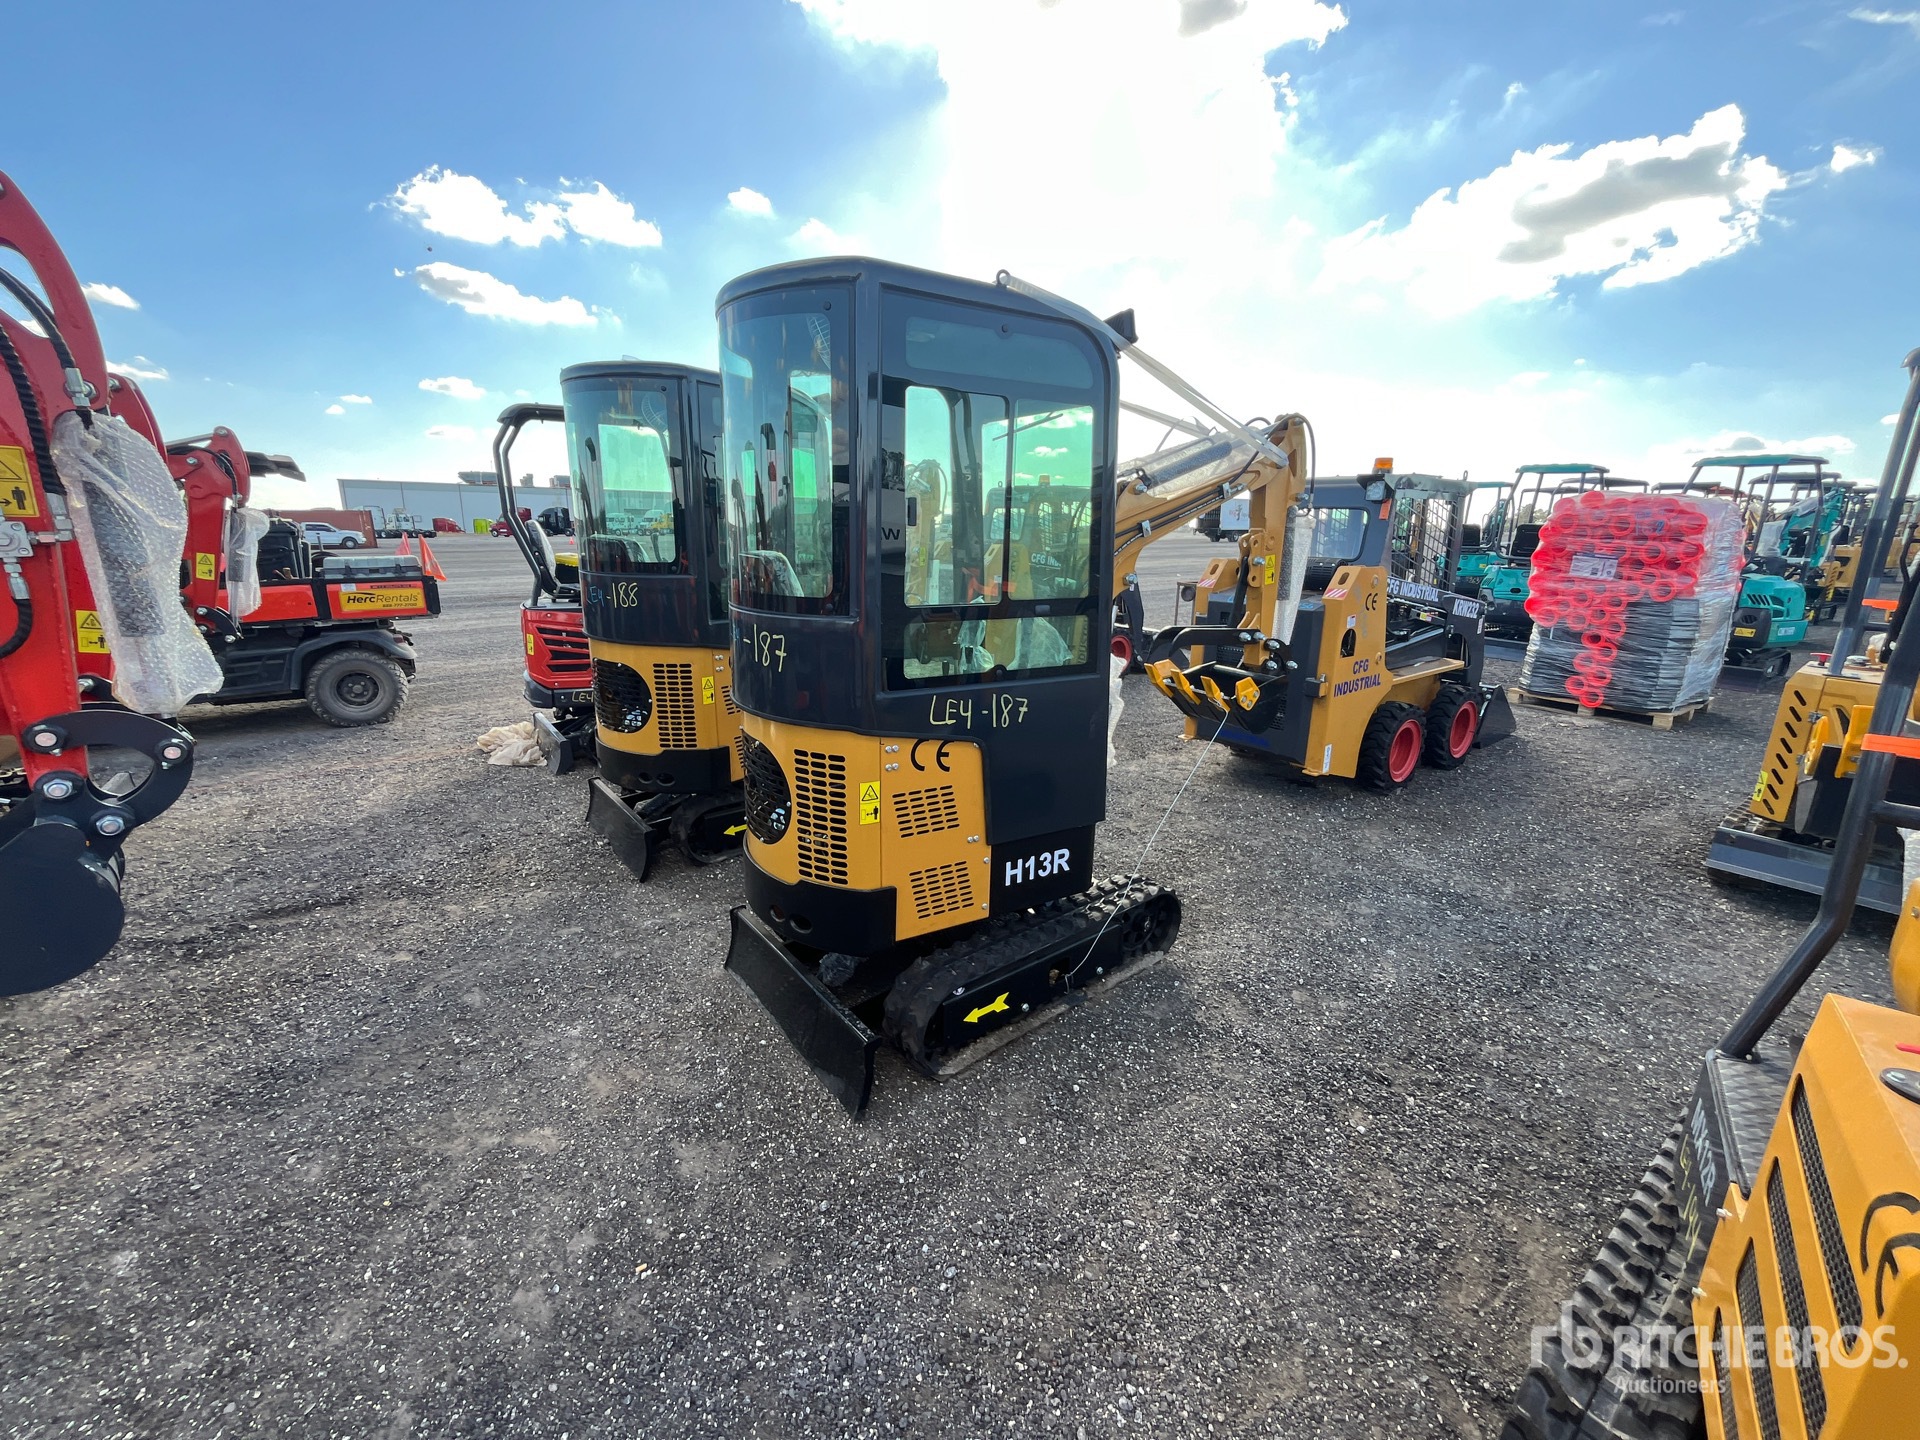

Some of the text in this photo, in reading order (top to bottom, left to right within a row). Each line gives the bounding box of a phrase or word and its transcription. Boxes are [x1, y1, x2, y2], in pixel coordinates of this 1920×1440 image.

[1365, 592, 1379, 611] CE
[1400, 581, 1439, 602] INDUSTRIAL
[1452, 598, 1480, 619] KRW232
[1352, 659, 1369, 675] CFG
[1333, 673, 1381, 698] INDUSTRIAL
[910, 738, 955, 773] CE
[1005, 848, 1070, 887] H13R
